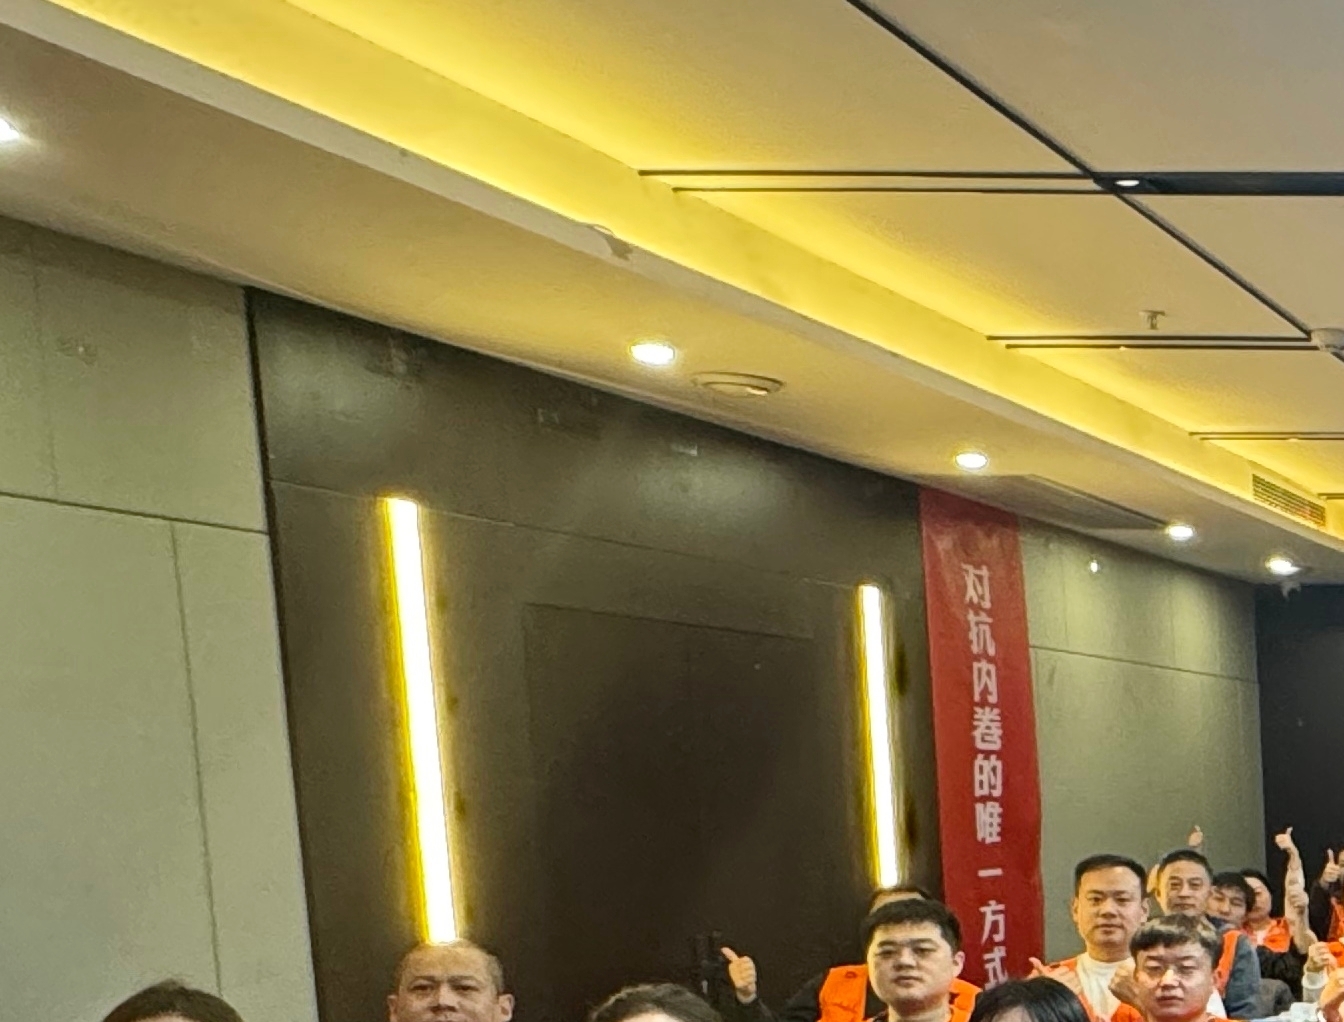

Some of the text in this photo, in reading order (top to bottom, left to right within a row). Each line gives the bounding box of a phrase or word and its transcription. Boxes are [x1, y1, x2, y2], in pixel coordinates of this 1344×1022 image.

[961, 562, 1009, 990] 对抗内卷的唯一方式
